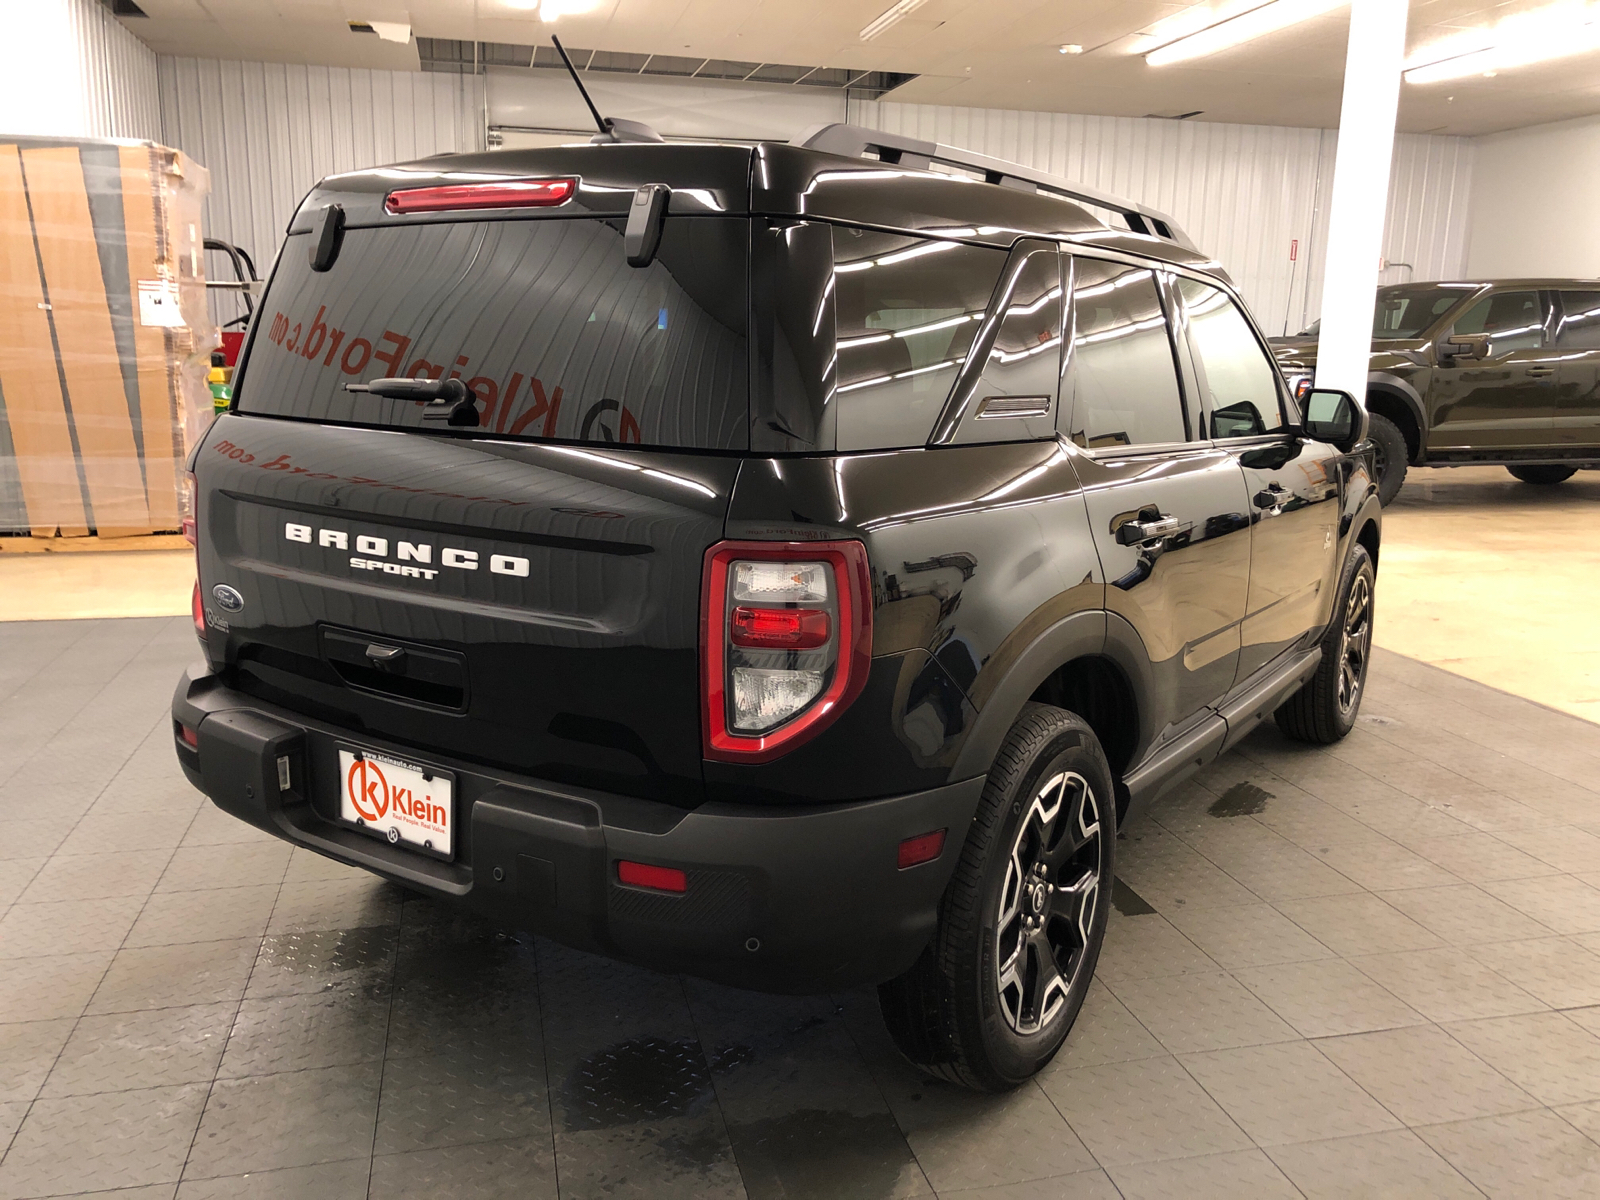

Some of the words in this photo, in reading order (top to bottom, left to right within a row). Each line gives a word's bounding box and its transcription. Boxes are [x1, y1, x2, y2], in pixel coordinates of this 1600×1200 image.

[285, 522, 530, 578] BRONCO
[350, 557, 439, 580] SPORT
[361, 751, 423, 773] www.kleinauto.com
[392, 785, 447, 826] Klein
[392, 812, 403, 821] Real
[420, 821, 431, 830] Real
